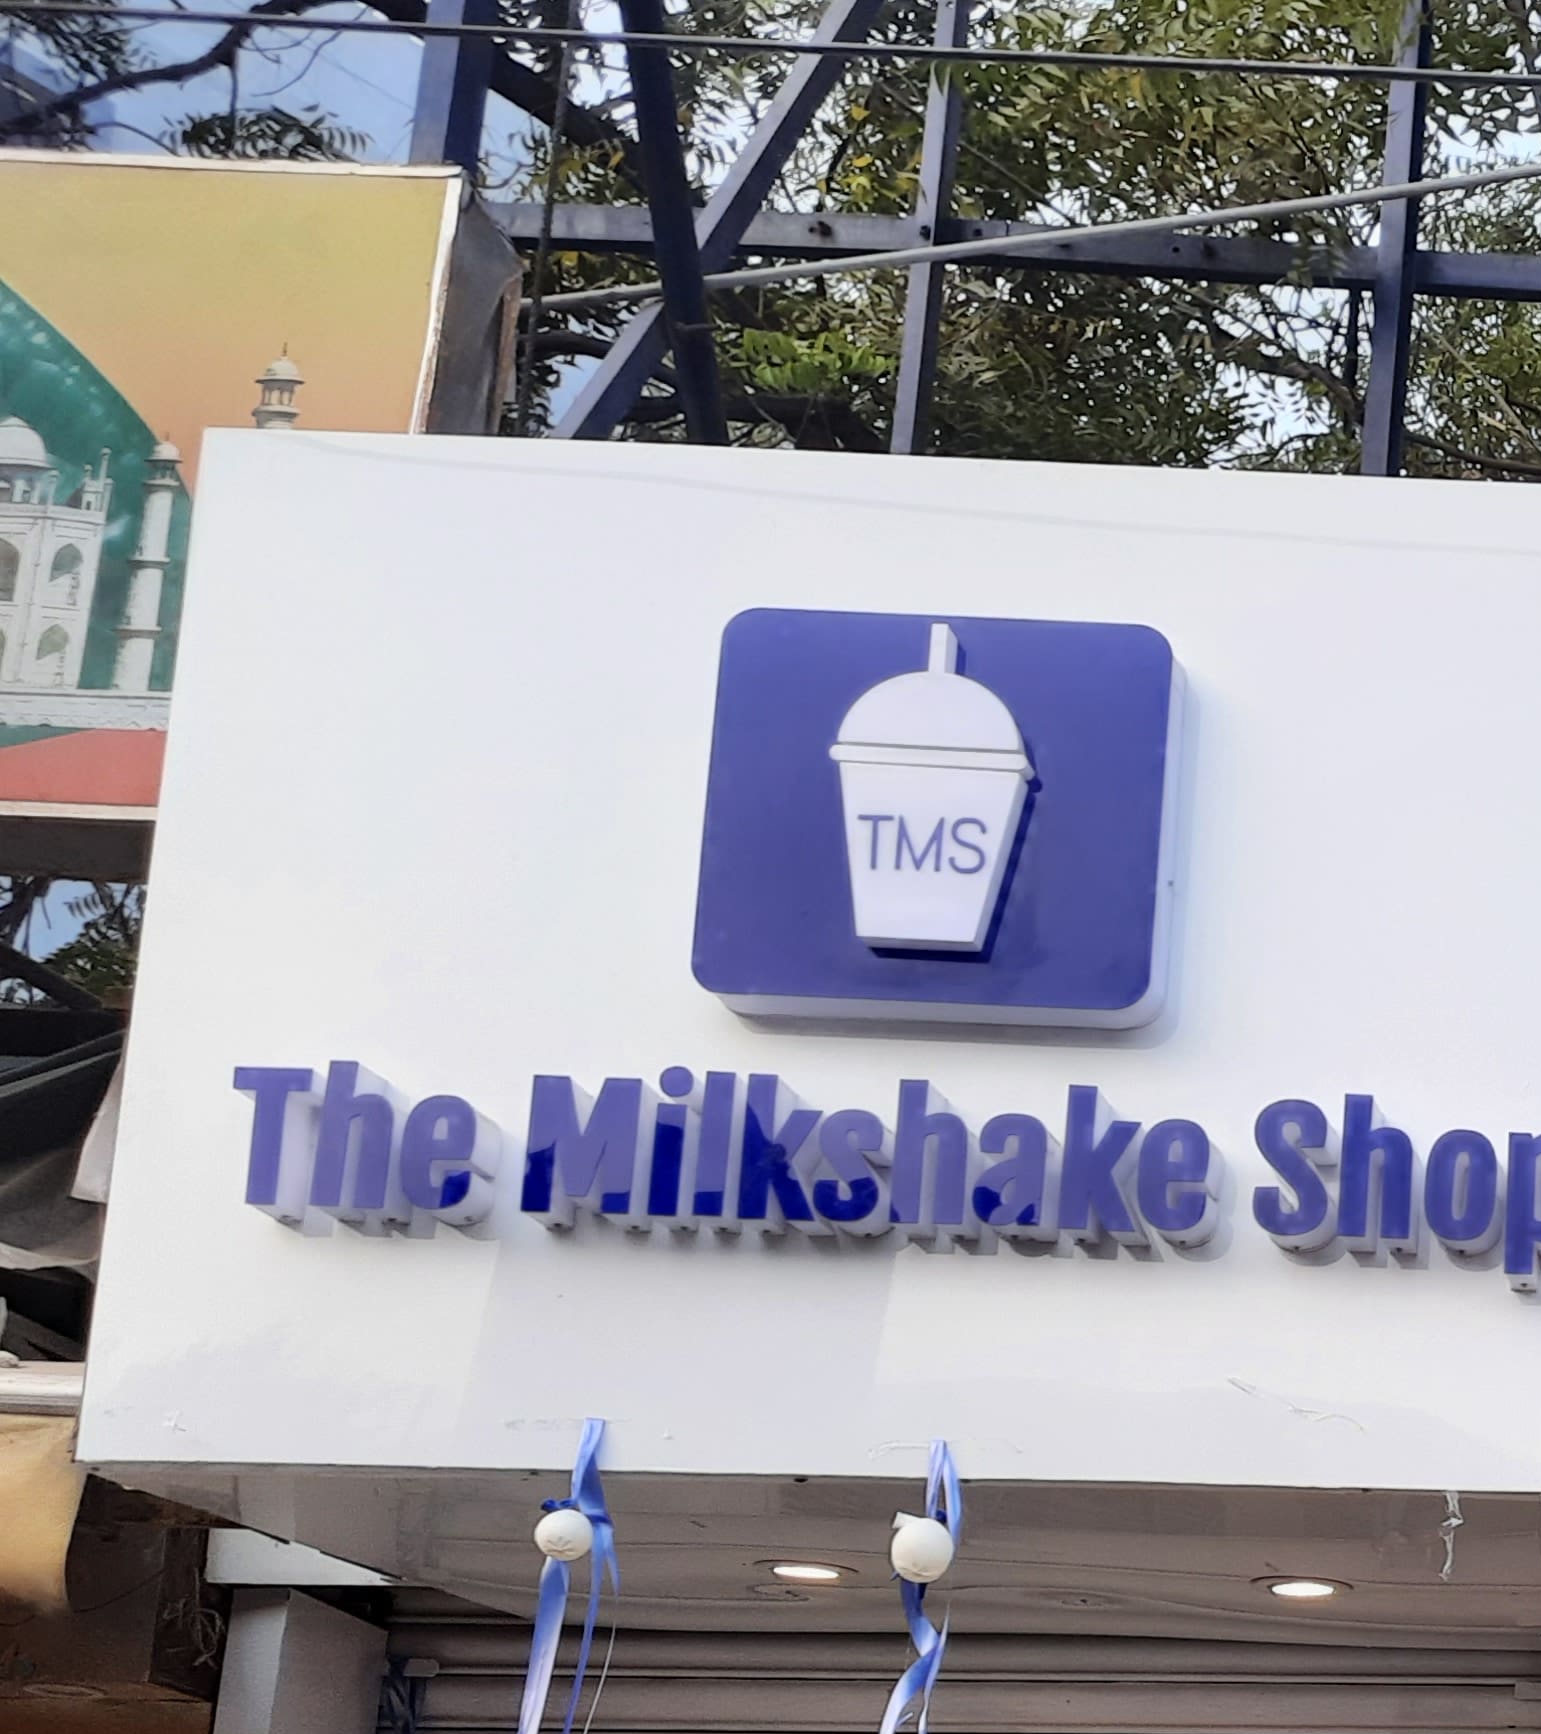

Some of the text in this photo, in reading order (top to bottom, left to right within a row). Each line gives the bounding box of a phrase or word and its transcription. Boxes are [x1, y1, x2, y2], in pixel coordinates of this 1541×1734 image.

[857, 814, 987, 874] TMS
[232, 1060, 478, 1212] The
[519, 1065, 1212, 1235] Milkshake
